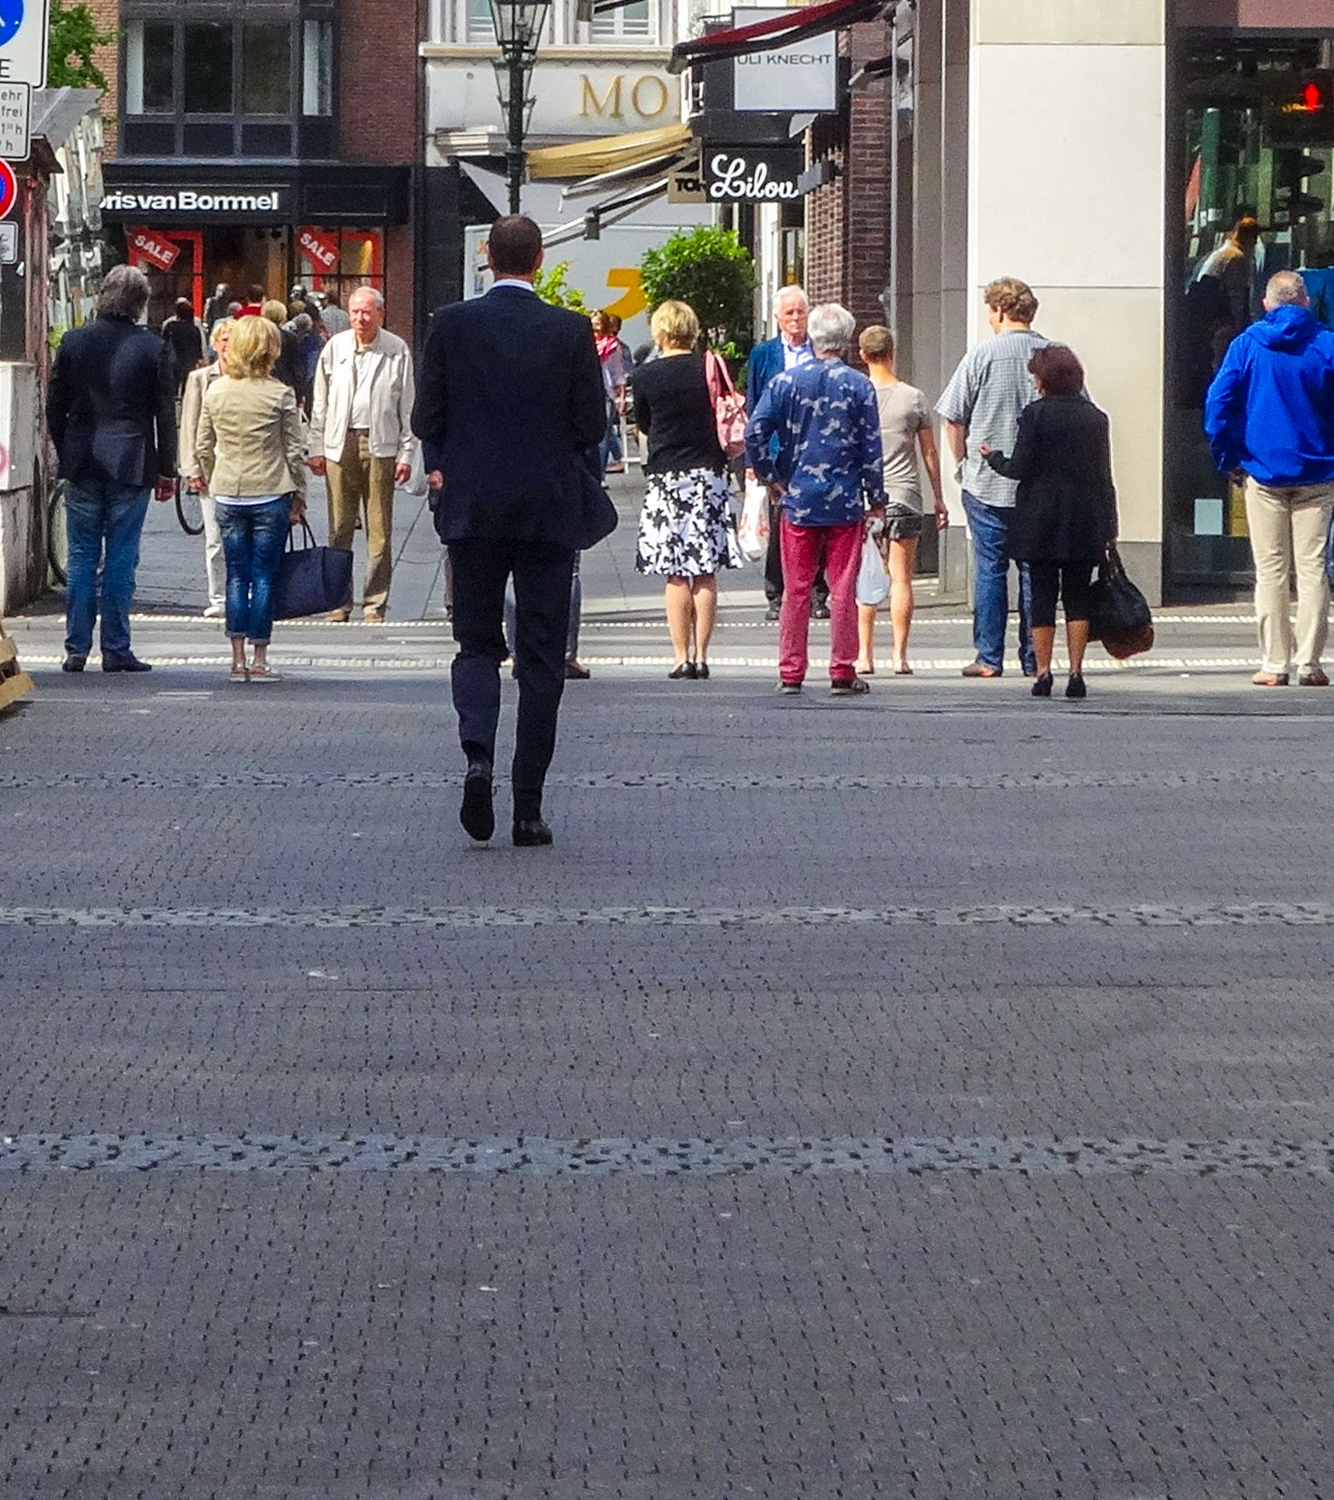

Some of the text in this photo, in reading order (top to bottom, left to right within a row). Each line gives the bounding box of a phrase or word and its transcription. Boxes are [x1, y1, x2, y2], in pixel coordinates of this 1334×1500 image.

[736, 54, 832, 66] ULI KNECHT
[1, 104, 23, 117] frei
[578, 73, 680, 120] MO
[709, 154, 799, 200] Lilou
[178, 191, 279, 211] Bommel
[133, 233, 174, 264] SALE
[299, 231, 337, 267] SALE
